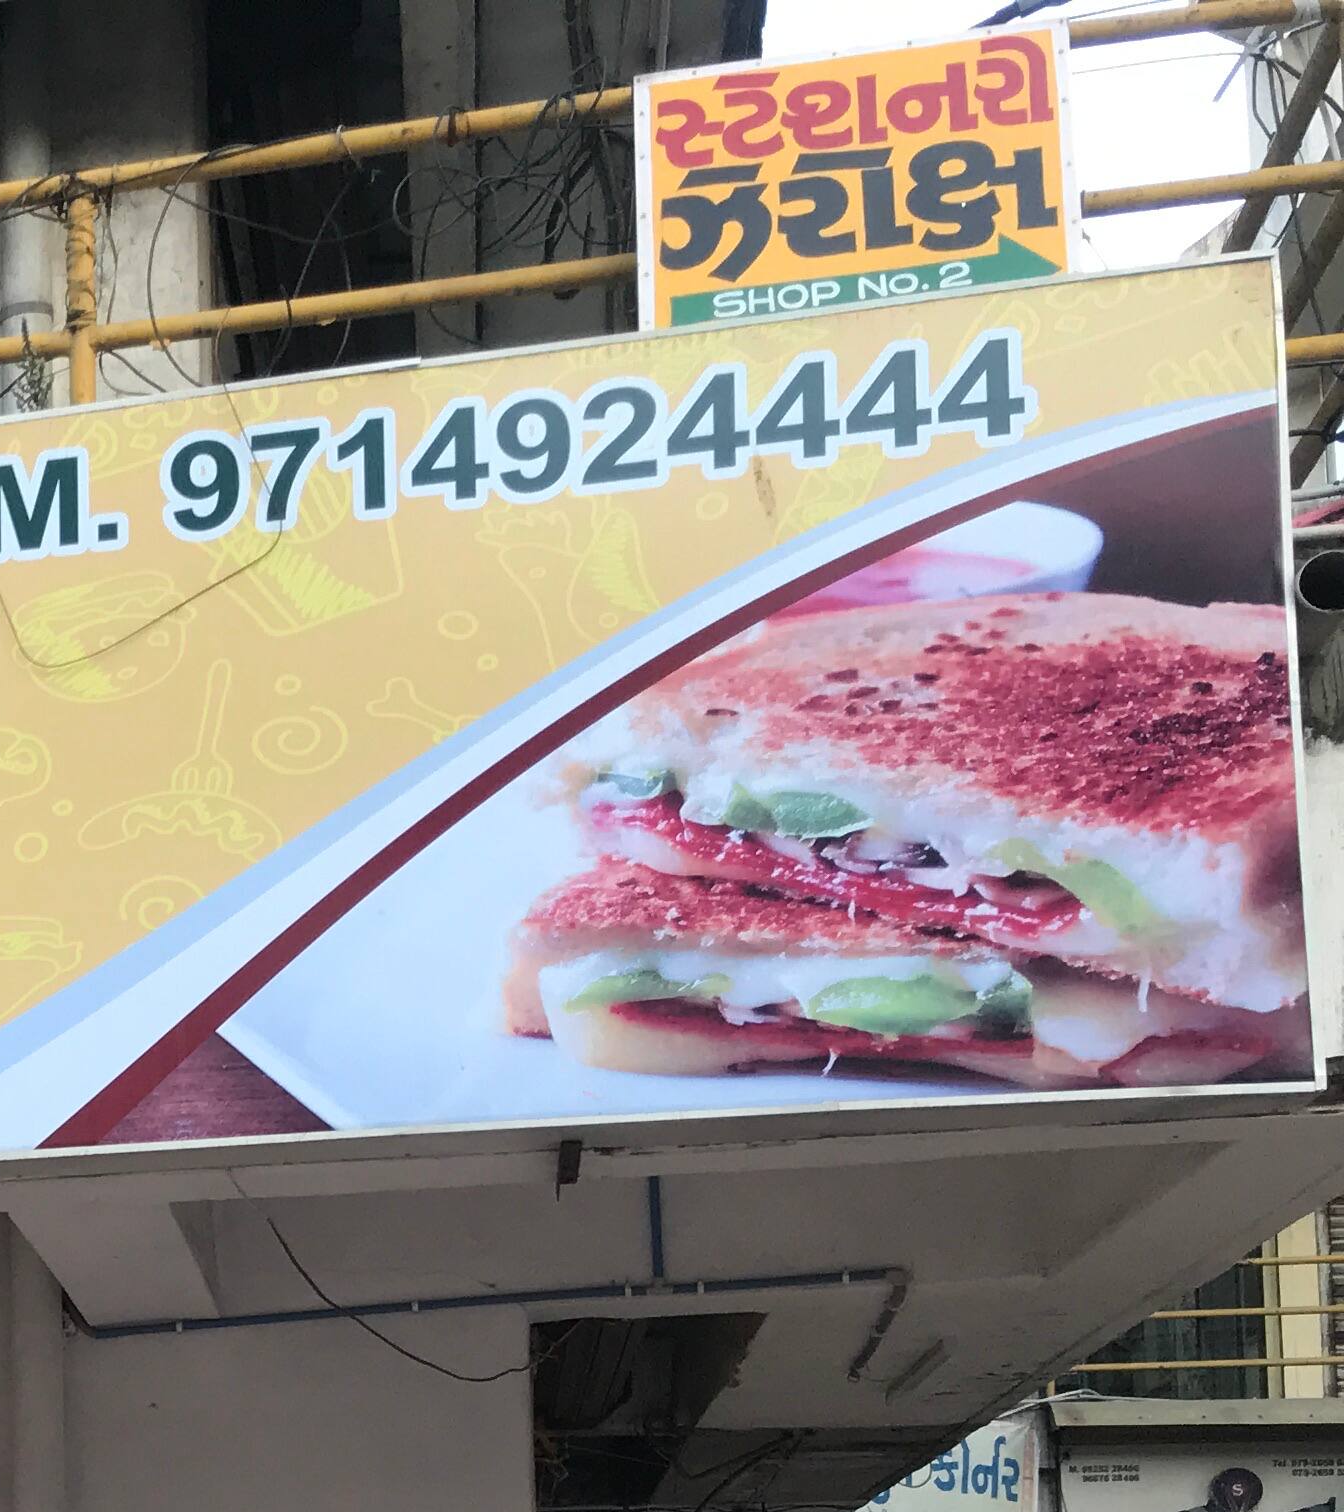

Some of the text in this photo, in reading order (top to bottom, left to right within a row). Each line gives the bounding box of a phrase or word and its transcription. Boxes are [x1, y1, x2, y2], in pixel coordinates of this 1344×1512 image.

[712, 279, 840, 319] SHOP
[939, 261, 974, 289] 2
[170, 335, 1027, 533] 9714924444
